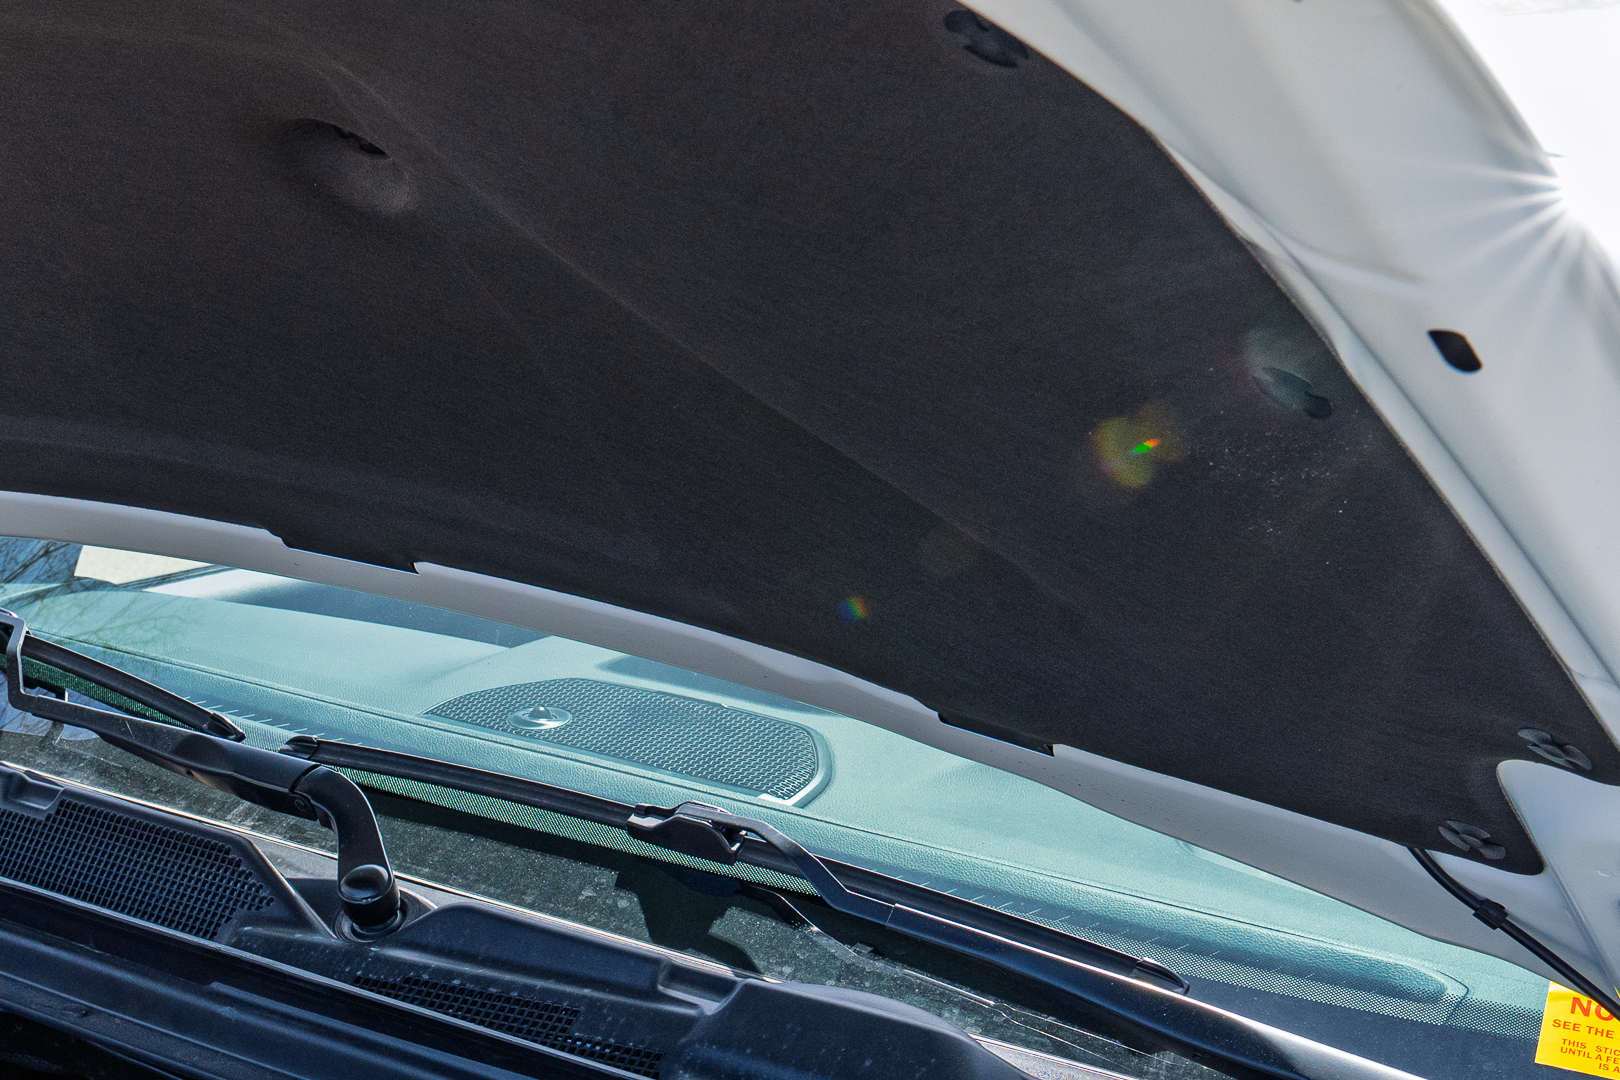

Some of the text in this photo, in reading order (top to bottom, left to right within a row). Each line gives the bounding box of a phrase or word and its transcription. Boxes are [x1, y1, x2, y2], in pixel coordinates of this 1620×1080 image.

[1552, 1019, 1615, 1039] SEE THE
[1561, 1038, 1587, 1049] THIS
[1560, 1046, 1592, 1059] UNTIL
[1598, 1062, 1609, 1071] IS
